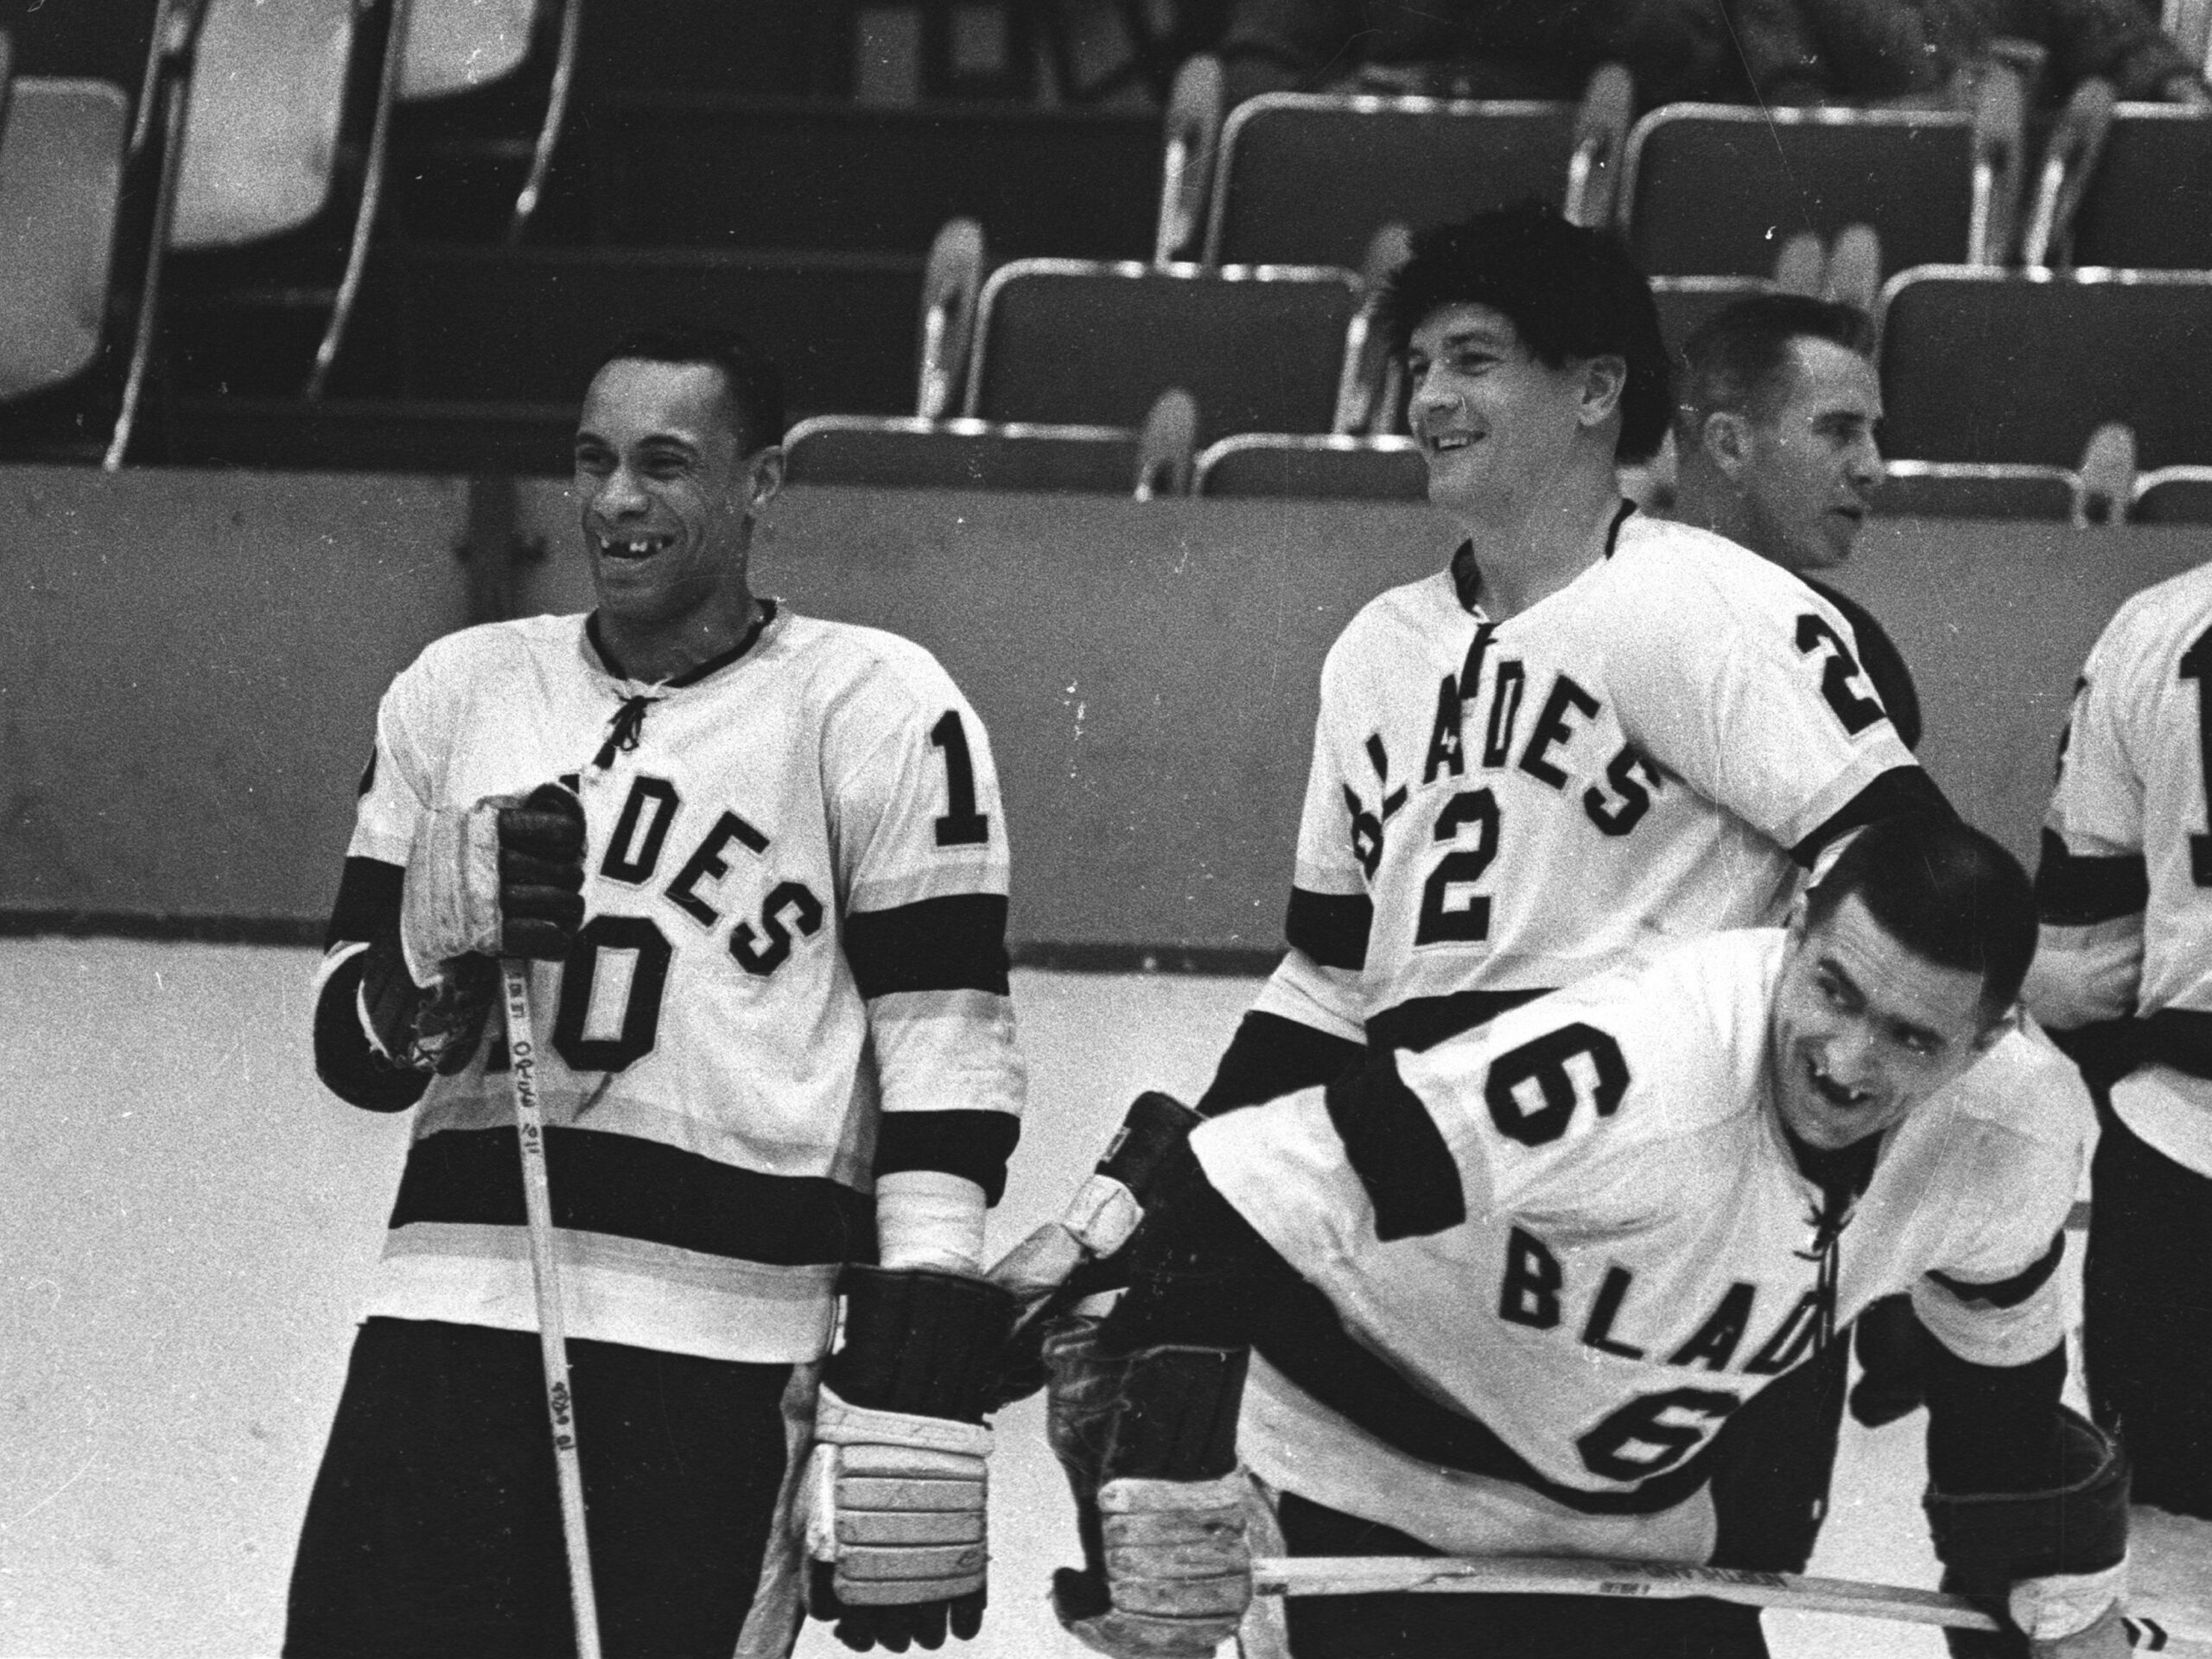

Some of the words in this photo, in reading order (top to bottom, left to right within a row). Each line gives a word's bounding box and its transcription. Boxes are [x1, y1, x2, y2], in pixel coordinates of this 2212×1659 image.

[1795, 612, 1886, 736] 2
[931, 709, 990, 846] 1
[1342, 660, 1662, 883] BLADES
[559, 772, 825, 977] DES
[1414, 786, 1501, 947] 2
[486, 913, 672, 1073] 0
[1484, 1020, 1630, 1147] 6
[1575, 1386, 1741, 1482] 6
